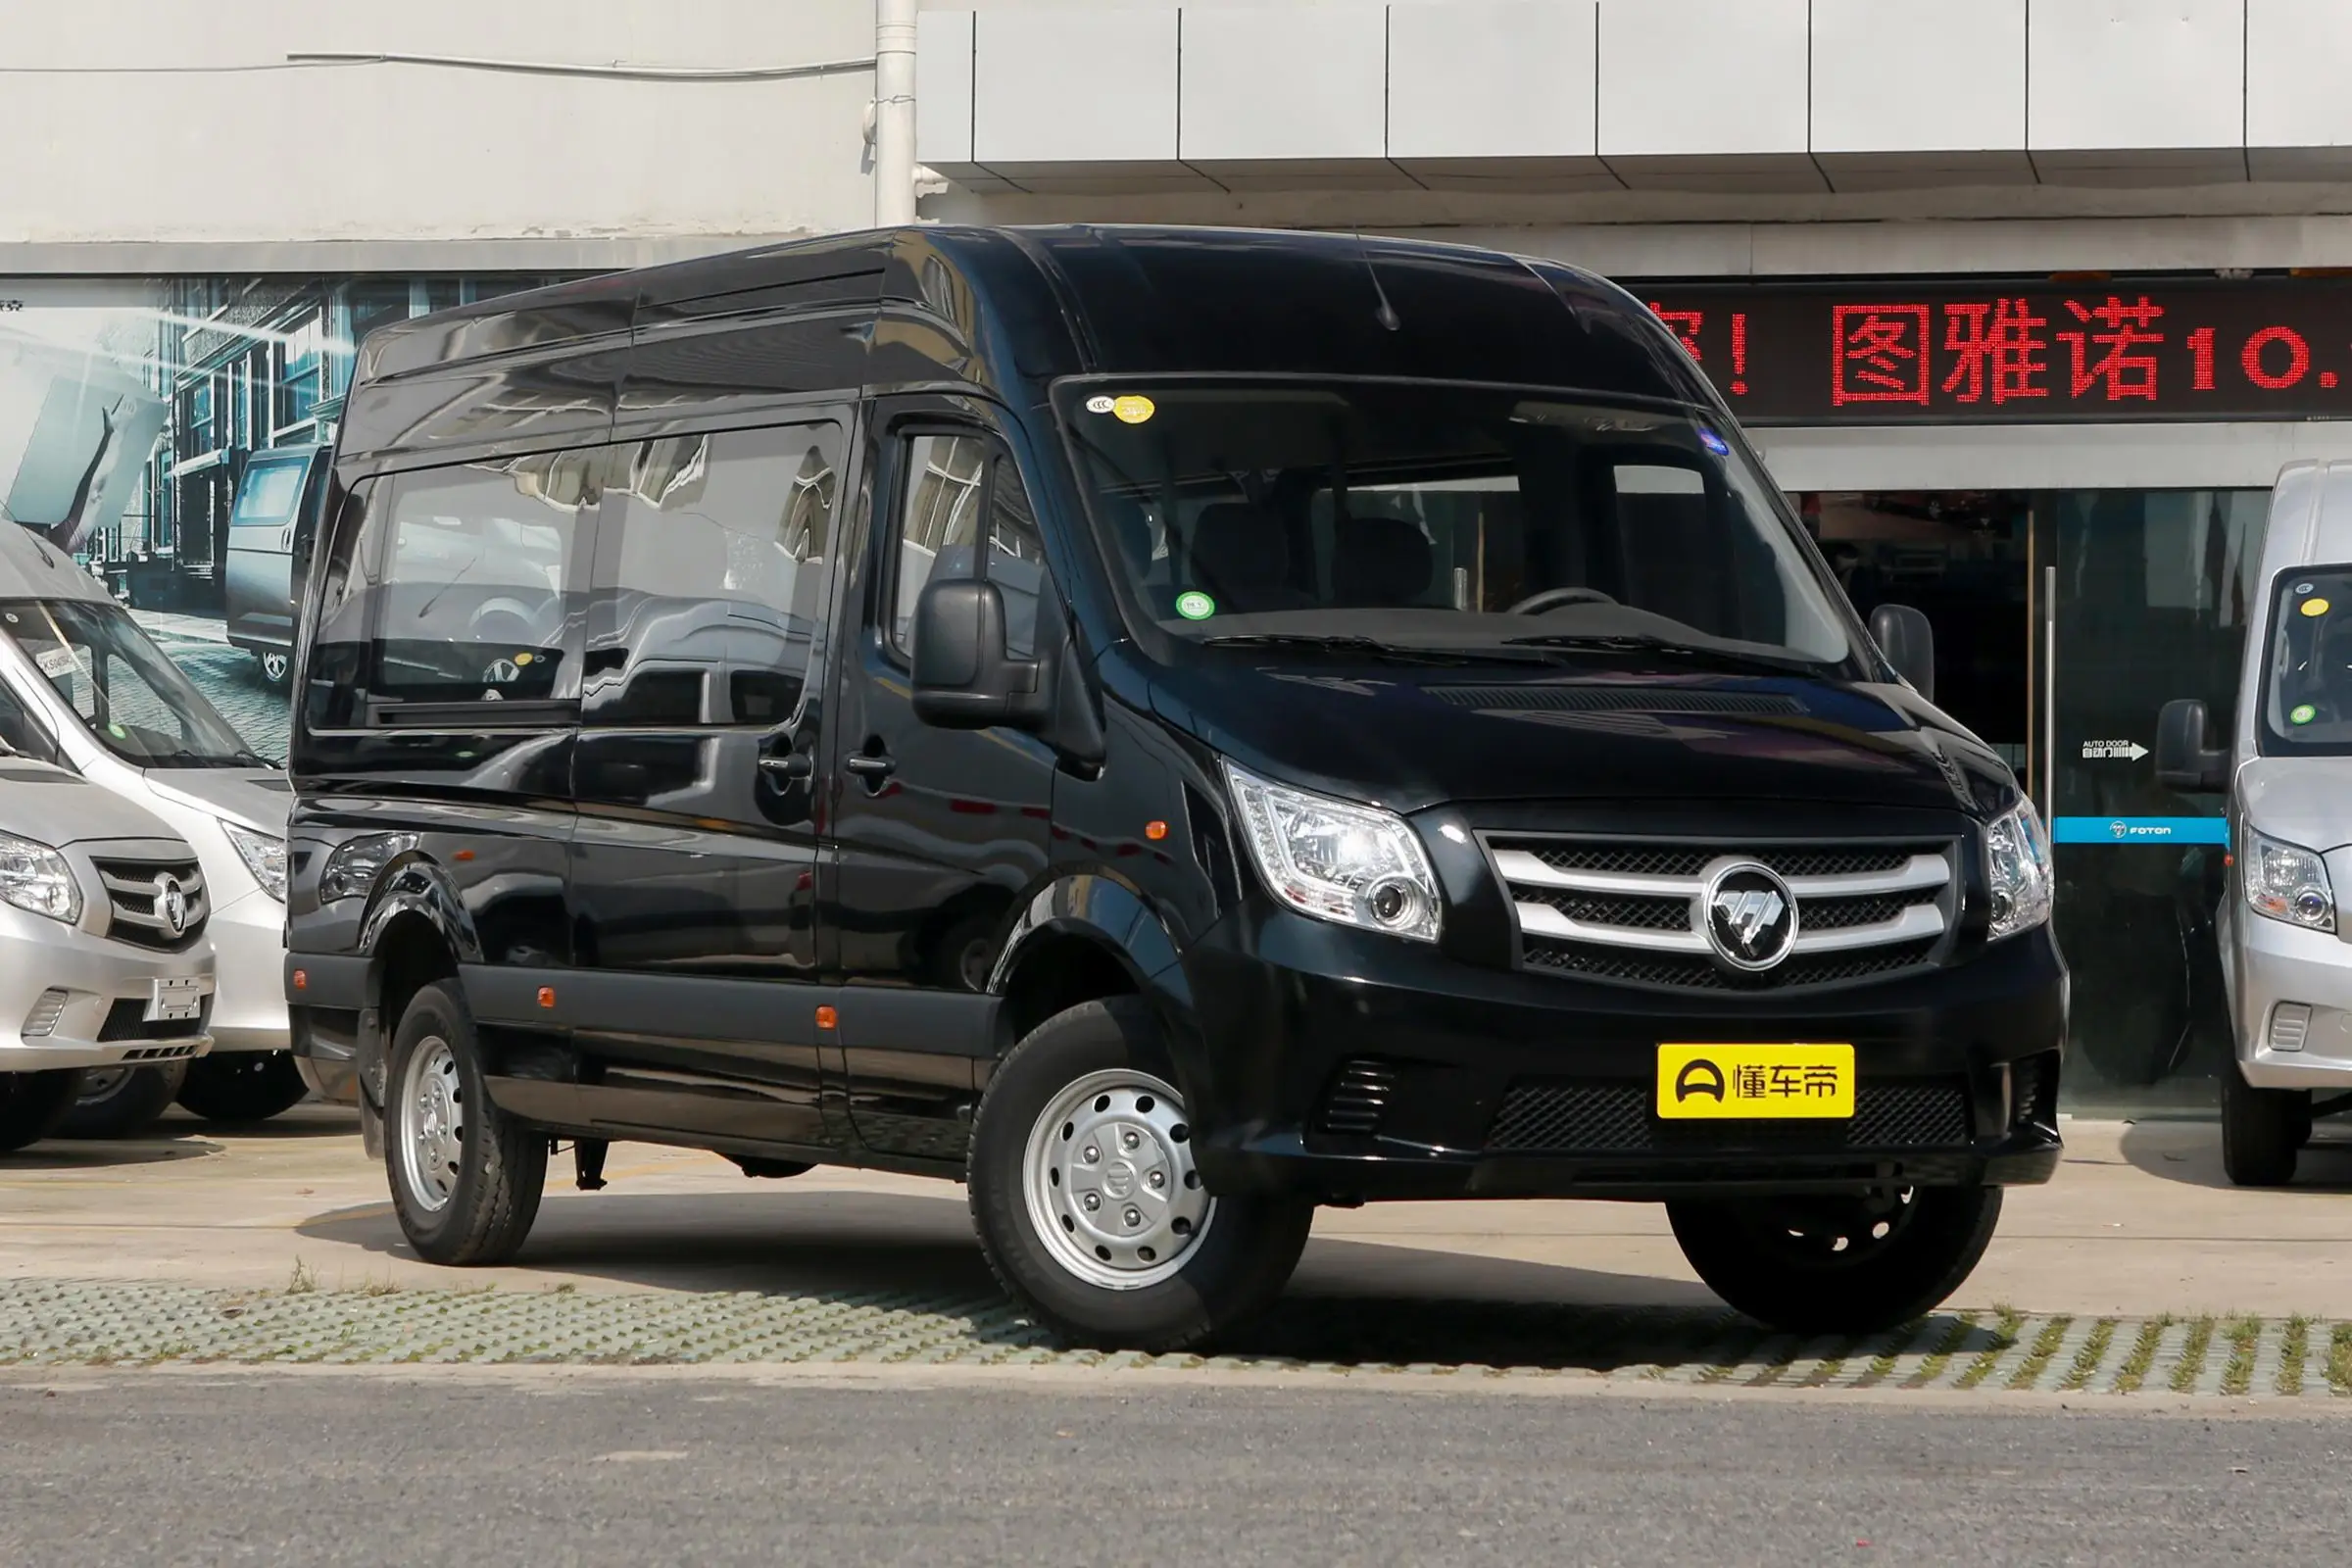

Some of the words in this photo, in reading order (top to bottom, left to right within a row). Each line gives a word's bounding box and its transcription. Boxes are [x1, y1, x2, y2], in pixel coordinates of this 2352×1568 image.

[1831, 295, 2352, 406] 图雅诺10.
[2130, 826, 2172, 835] FOTON
[1733, 1064, 1838, 1099] 懂车帝
